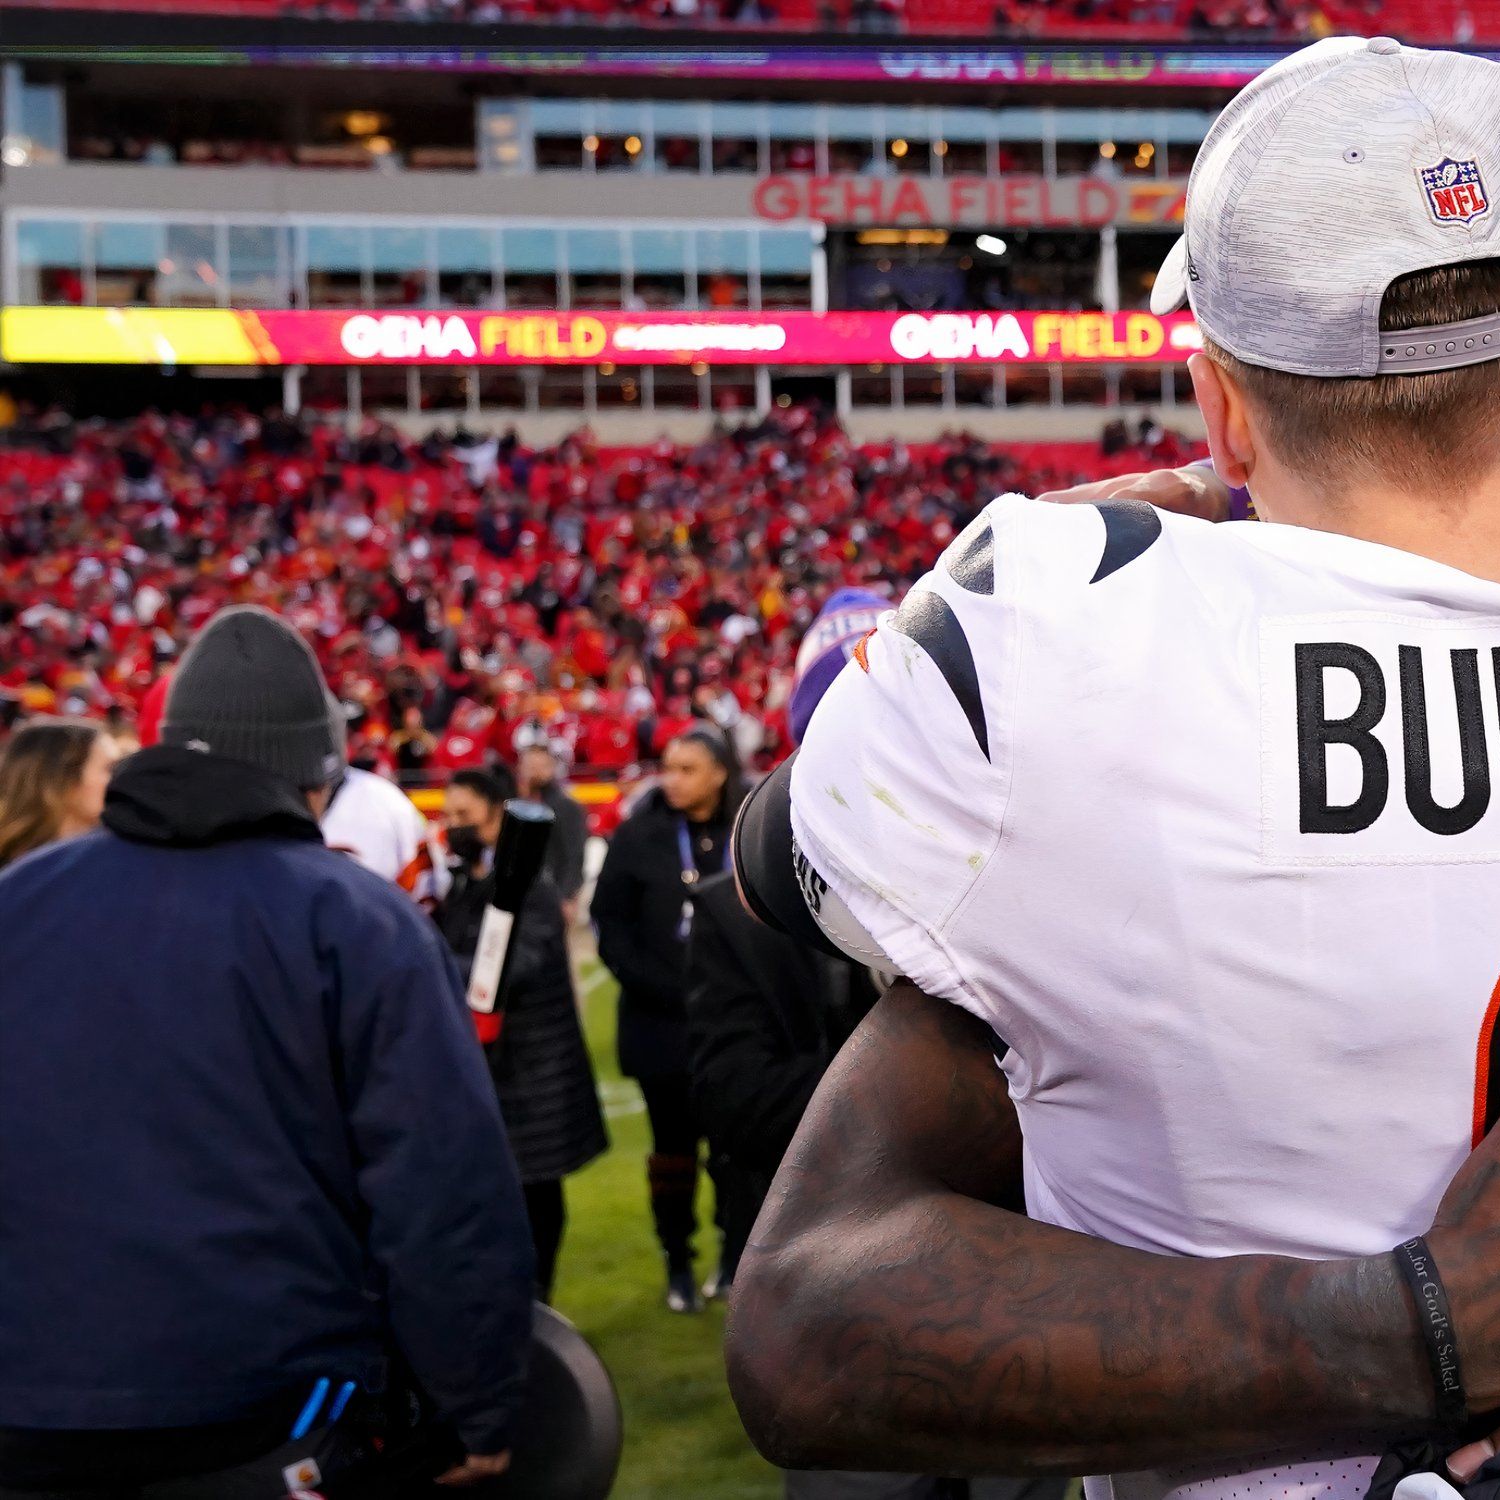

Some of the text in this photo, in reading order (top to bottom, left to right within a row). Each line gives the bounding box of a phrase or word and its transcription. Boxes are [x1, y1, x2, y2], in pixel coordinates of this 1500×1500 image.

[753, 176, 1120, 227] GEHA FIELD
[1433, 184, 1485, 217] NFL
[1033, 313, 1165, 358] FIELD
[1422, 1281, 1449, 1339] God's
